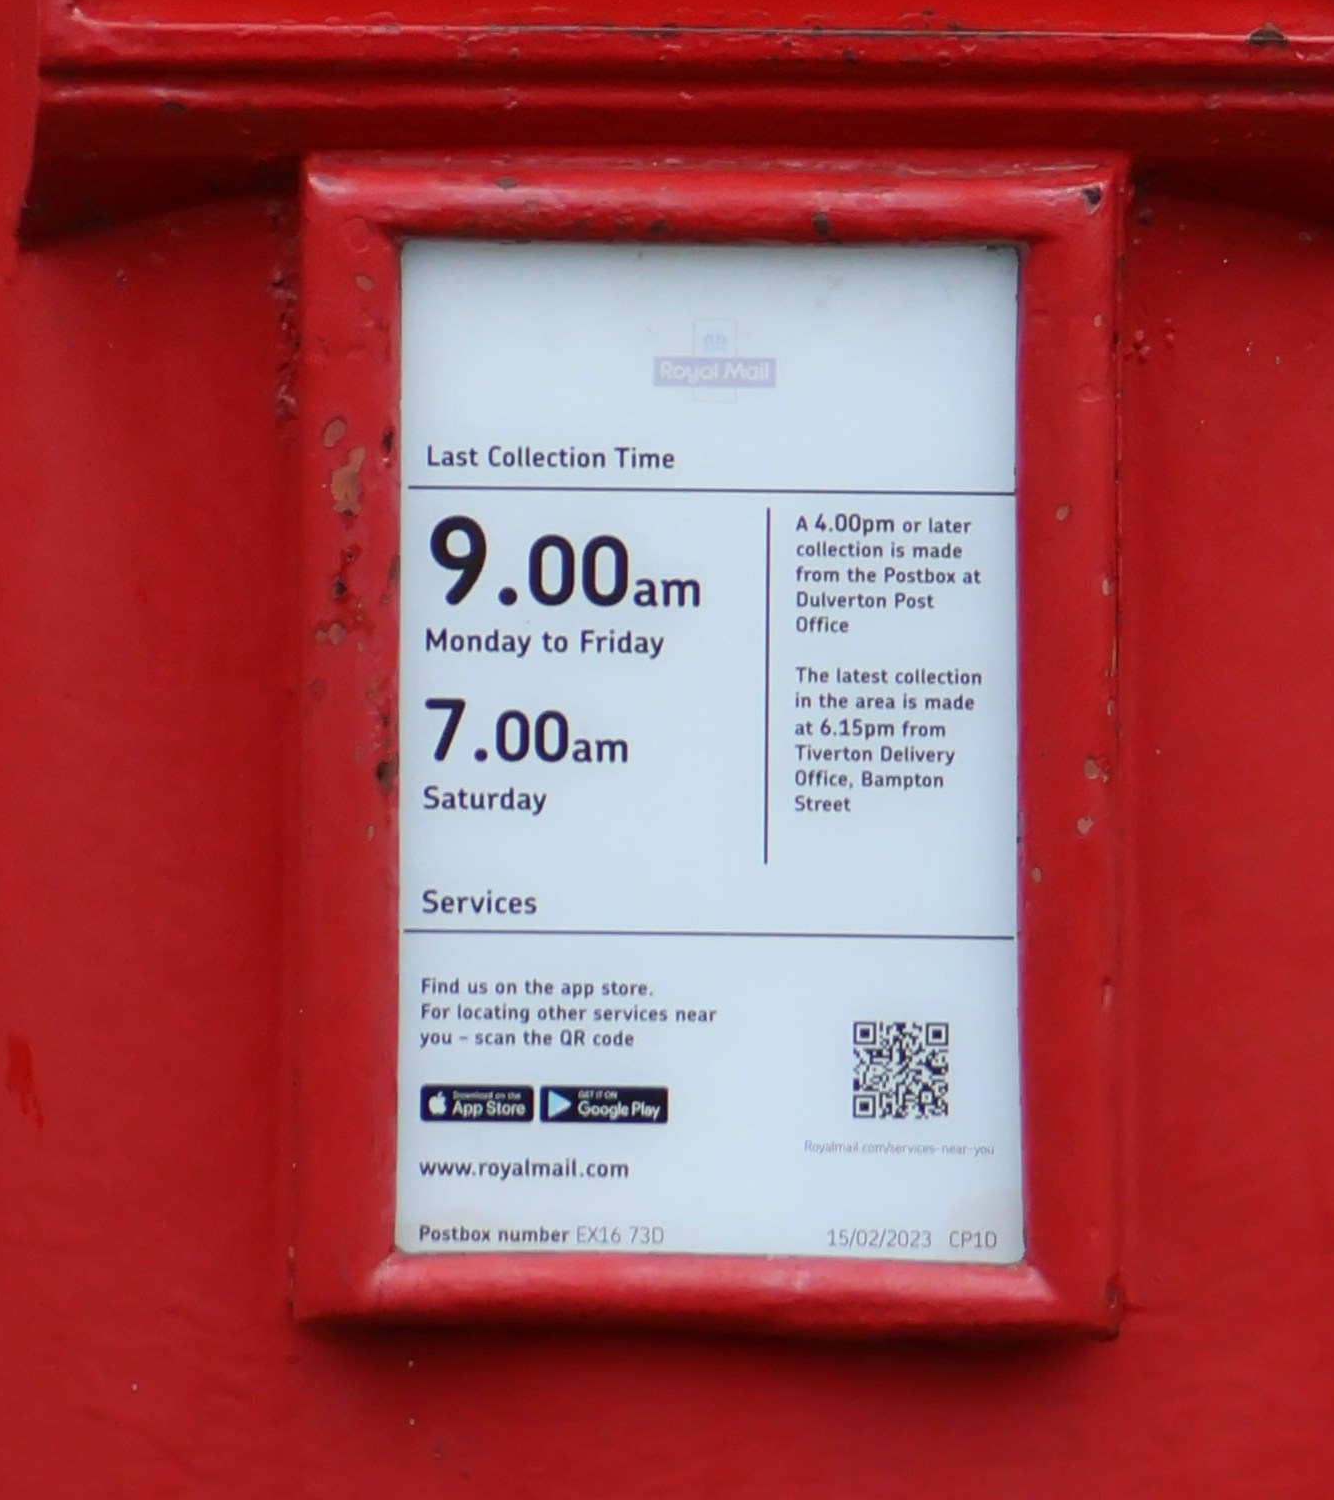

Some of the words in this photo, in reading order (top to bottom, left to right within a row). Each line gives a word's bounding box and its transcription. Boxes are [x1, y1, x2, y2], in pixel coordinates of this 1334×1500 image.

[659, 361, 718, 384] Royal
[723, 361, 770, 381] Mail
[427, 445, 479, 467] Last
[488, 445, 606, 468] Collection
[614, 447, 675, 469] Time
[795, 515, 809, 532] A
[814, 513, 895, 537] 4.00pm
[902, 520, 922, 533] or
[928, 517, 972, 534] later
[796, 541, 884, 558] collection
[890, 541, 905, 558] is
[912, 542, 963, 559] made
[429, 515, 701, 608] 9.00am
[795, 565, 840, 583] from
[847, 566, 877, 583] the
[884, 566, 956, 584] Postbox
[962, 569, 981, 584] at
[796, 591, 886, 608] Dulverton
[894, 592, 934, 609] Post
[795, 616, 849, 633] Office
[425, 628, 532, 658] Monday
[542, 631, 568, 653] to
[580, 629, 664, 659] Friday
[795, 666, 828, 684] The
[836, 667, 888, 684] latest
[894, 668, 982, 686] collection
[795, 691, 812, 709] in
[818, 692, 849, 709] the
[855, 697, 896, 709] area
[902, 693, 917, 710] is
[925, 694, 975, 711] made
[424, 698, 628, 763] 7.00am
[794, 721, 813, 736] at
[819, 718, 895, 741] 6.15pm
[902, 720, 946, 738] from
[794, 744, 873, 762] Tiverton
[880, 745, 955, 766] Delivery
[795, 769, 853, 788] Office,
[861, 770, 944, 791] Bampton
[423, 785, 547, 816] Saturday
[794, 794, 851, 812] Street
[422, 889, 537, 915] Services
[421, 977, 460, 994] Find
[467, 982, 488, 995] us
[494, 982, 517, 995] on
[524, 979, 554, 995] the
[561, 983, 593, 999] app
[601, 981, 653, 996] store.
[421, 1003, 450, 1020] For
[457, 1003, 530, 1024] locating
[537, 1004, 587, 1021] other
[593, 1005, 668, 1022] services
[675, 1010, 717, 1022] near
[419, 1032, 452, 1049] you
[475, 1033, 516, 1046] scan
[522, 1029, 553, 1046] the
[559, 1029, 586, 1046] QR
[592, 1030, 635, 1047] code
[452, 1101, 483, 1119] App
[486, 1101, 526, 1116] Store
[577, 1101, 629, 1120] Google
[631, 1102, 661, 1121] Play
[419, 1158, 629, 1181] www.royalmail.com
[419, 1224, 490, 1242] Postbox
[498, 1226, 569, 1243] number
[576, 1225, 622, 1244] EX16
[629, 1226, 665, 1245] 73D
[827, 1228, 932, 1249] 15/02/2023
[949, 1230, 998, 1249] CP1D
